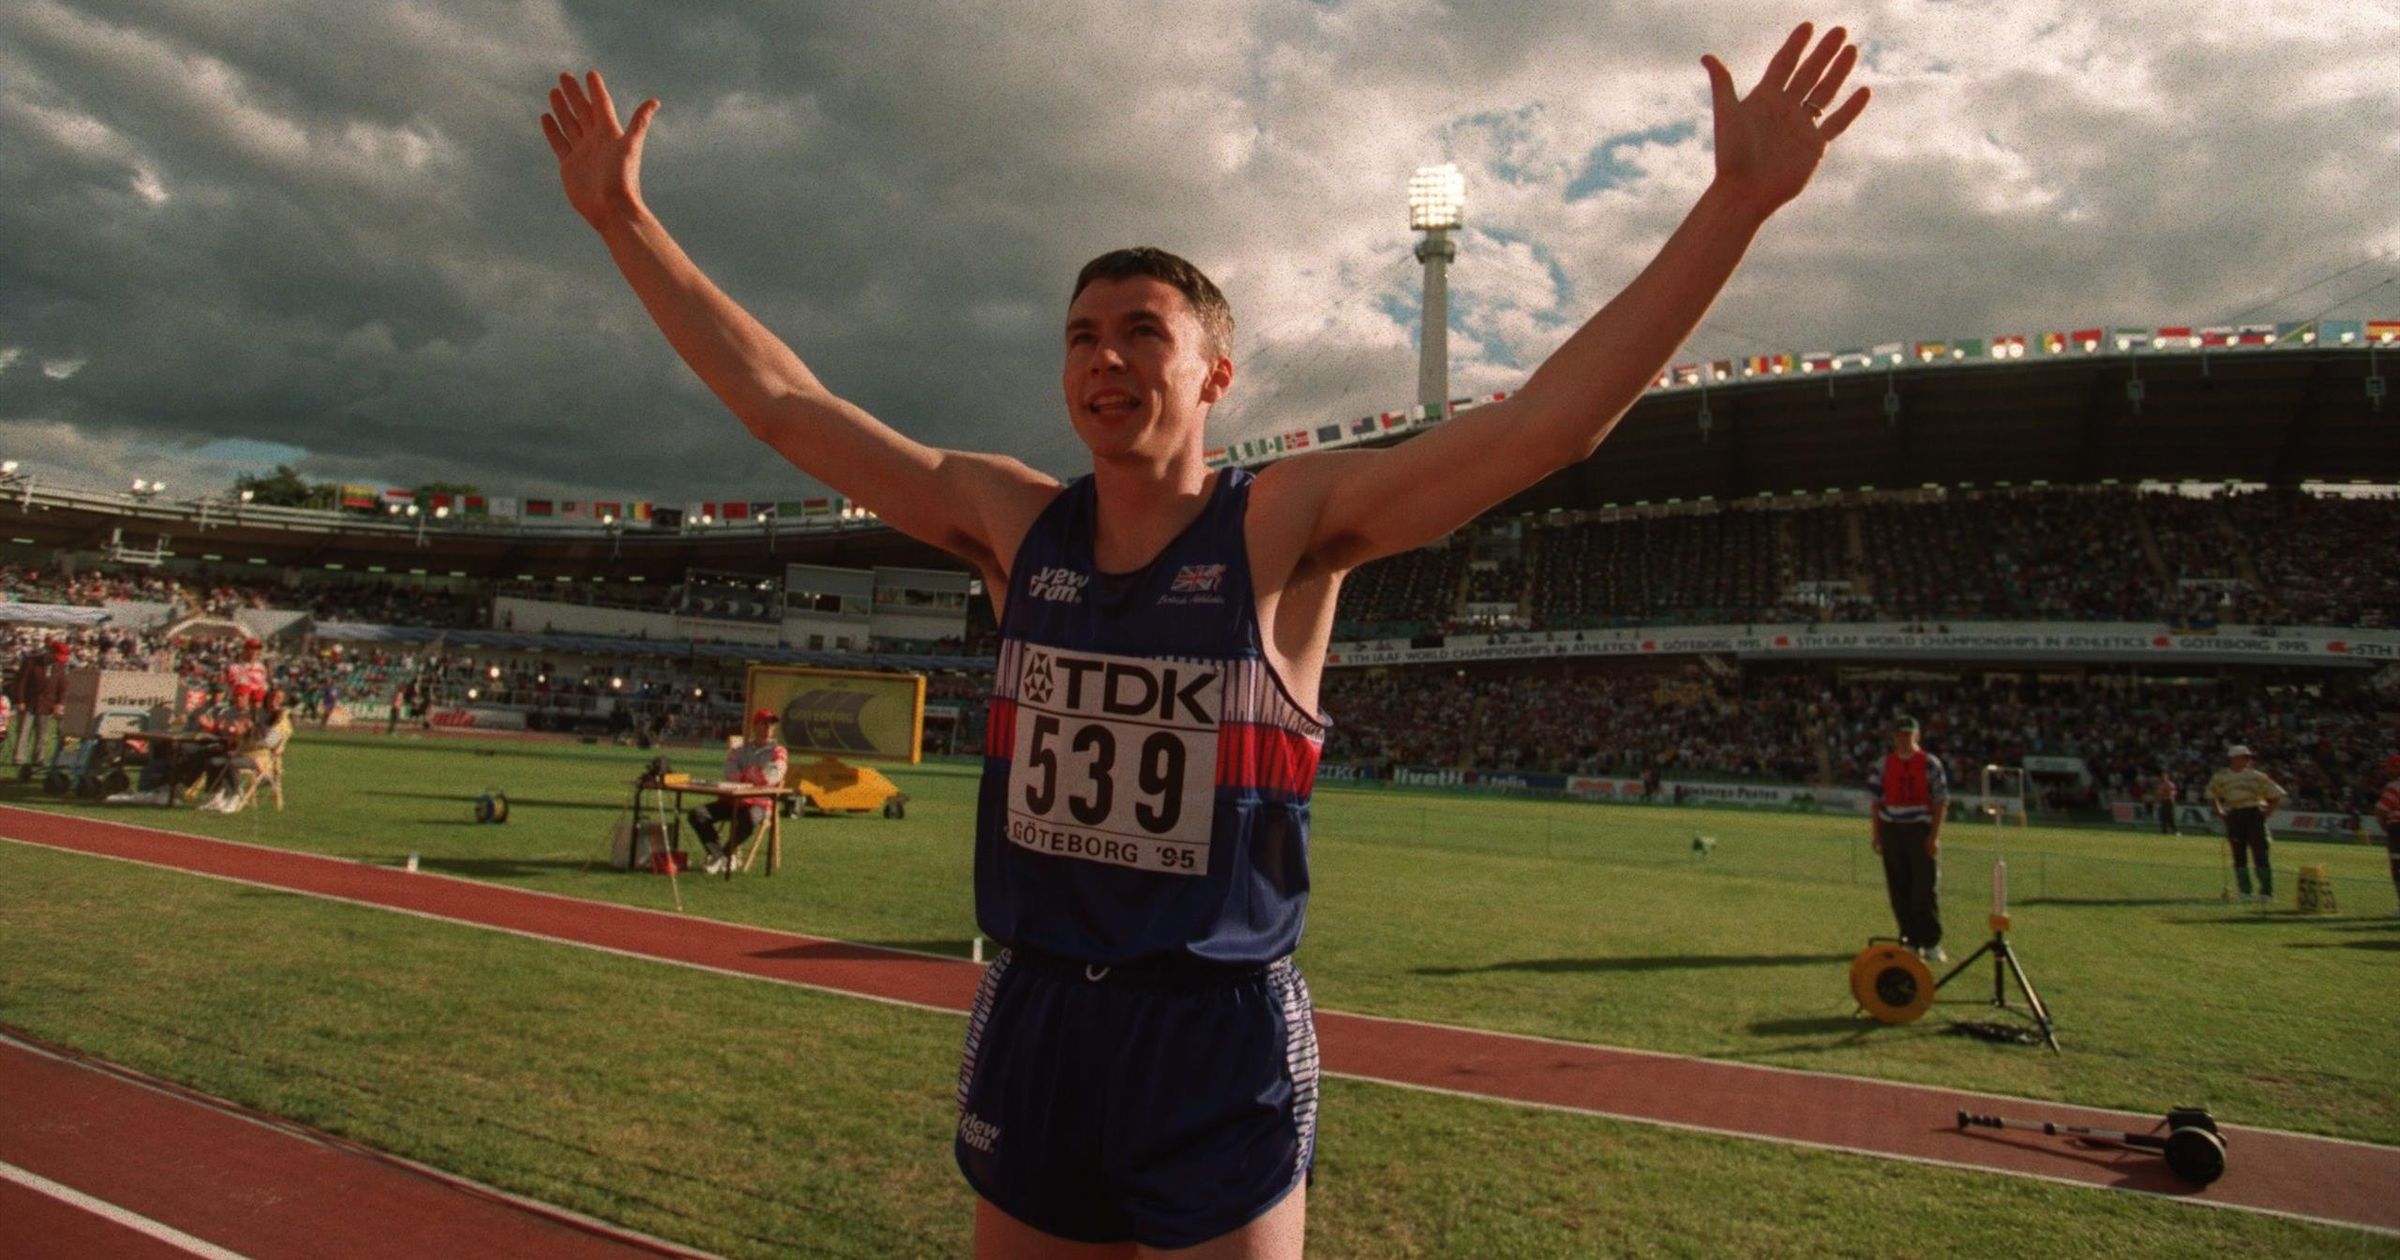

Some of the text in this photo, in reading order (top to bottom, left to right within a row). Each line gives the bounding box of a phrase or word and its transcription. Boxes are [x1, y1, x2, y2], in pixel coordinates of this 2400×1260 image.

[1407, 649, 1448, 661] WORLD
[1453, 644, 1551, 658] CHAMPIONSHIPS
[1573, 641, 1637, 652] ATHLETICS
[1921, 636, 2037, 647] CHAMPIONSHIPS
[2066, 637, 2146, 648] ATHLETICS
[2355, 643, 2391, 656] 5TH
[1055, 656, 1218, 725] TDK
[1026, 714, 1186, 834] 539
[1013, 820, 1196, 868] GÖTEBORG '95
